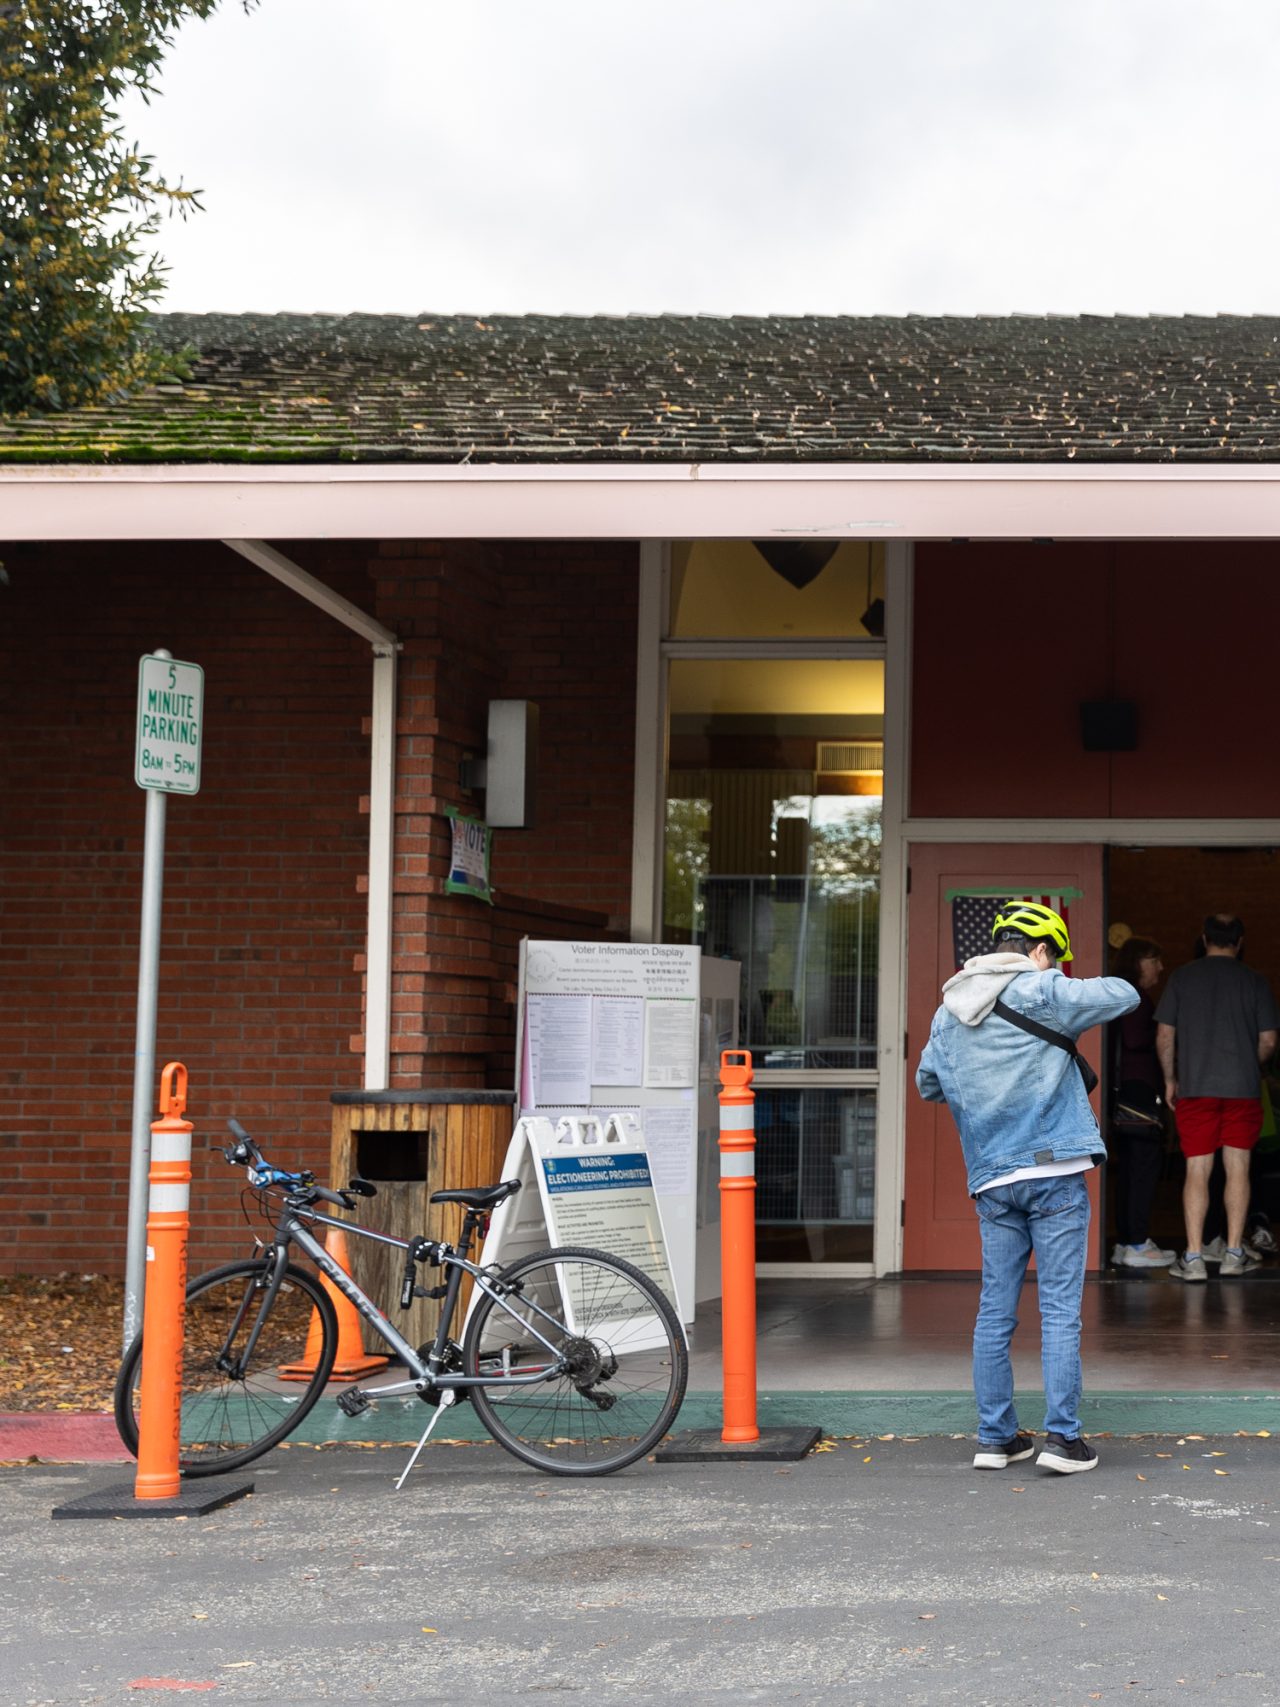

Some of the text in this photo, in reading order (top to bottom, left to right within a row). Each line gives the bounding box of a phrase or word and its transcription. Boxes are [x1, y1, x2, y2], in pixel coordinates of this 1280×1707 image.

[168, 666, 177, 689] 5
[147, 688, 195, 719] MINUTE
[142, 715, 197, 745] PARKING
[142, 749, 164, 771] 8AM
[174, 753, 195, 776] 5PM
[571, 945, 685, 959] Voter Information Display
[578, 1156, 616, 1168] WARNING:
[547, 1170, 609, 1185] ELECTIONEERING
[314, 1256, 379, 1323] GIANT
